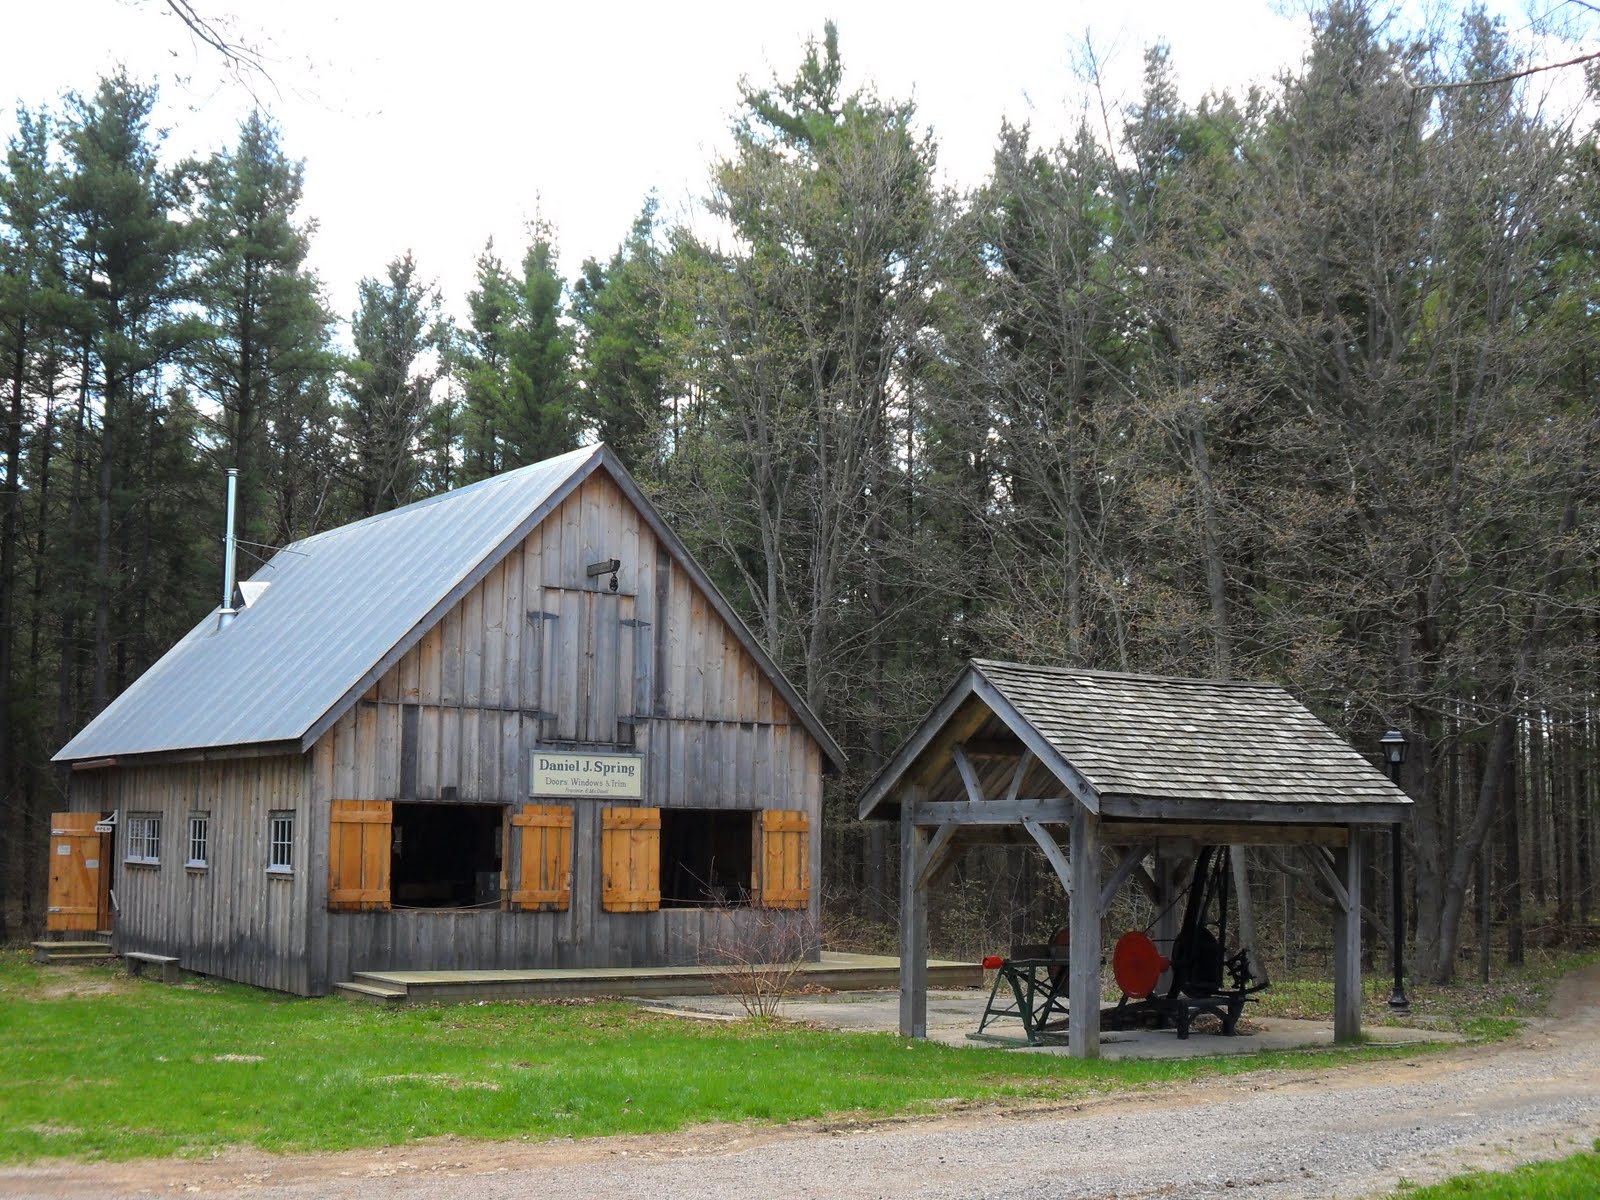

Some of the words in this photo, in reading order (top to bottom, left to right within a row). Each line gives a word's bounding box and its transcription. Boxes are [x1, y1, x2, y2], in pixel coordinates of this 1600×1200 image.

[539, 759, 580, 772] Daniel
[594, 761, 635, 777] Spring
[571, 778, 603, 787] Windows
[611, 779, 627, 788] Trim
